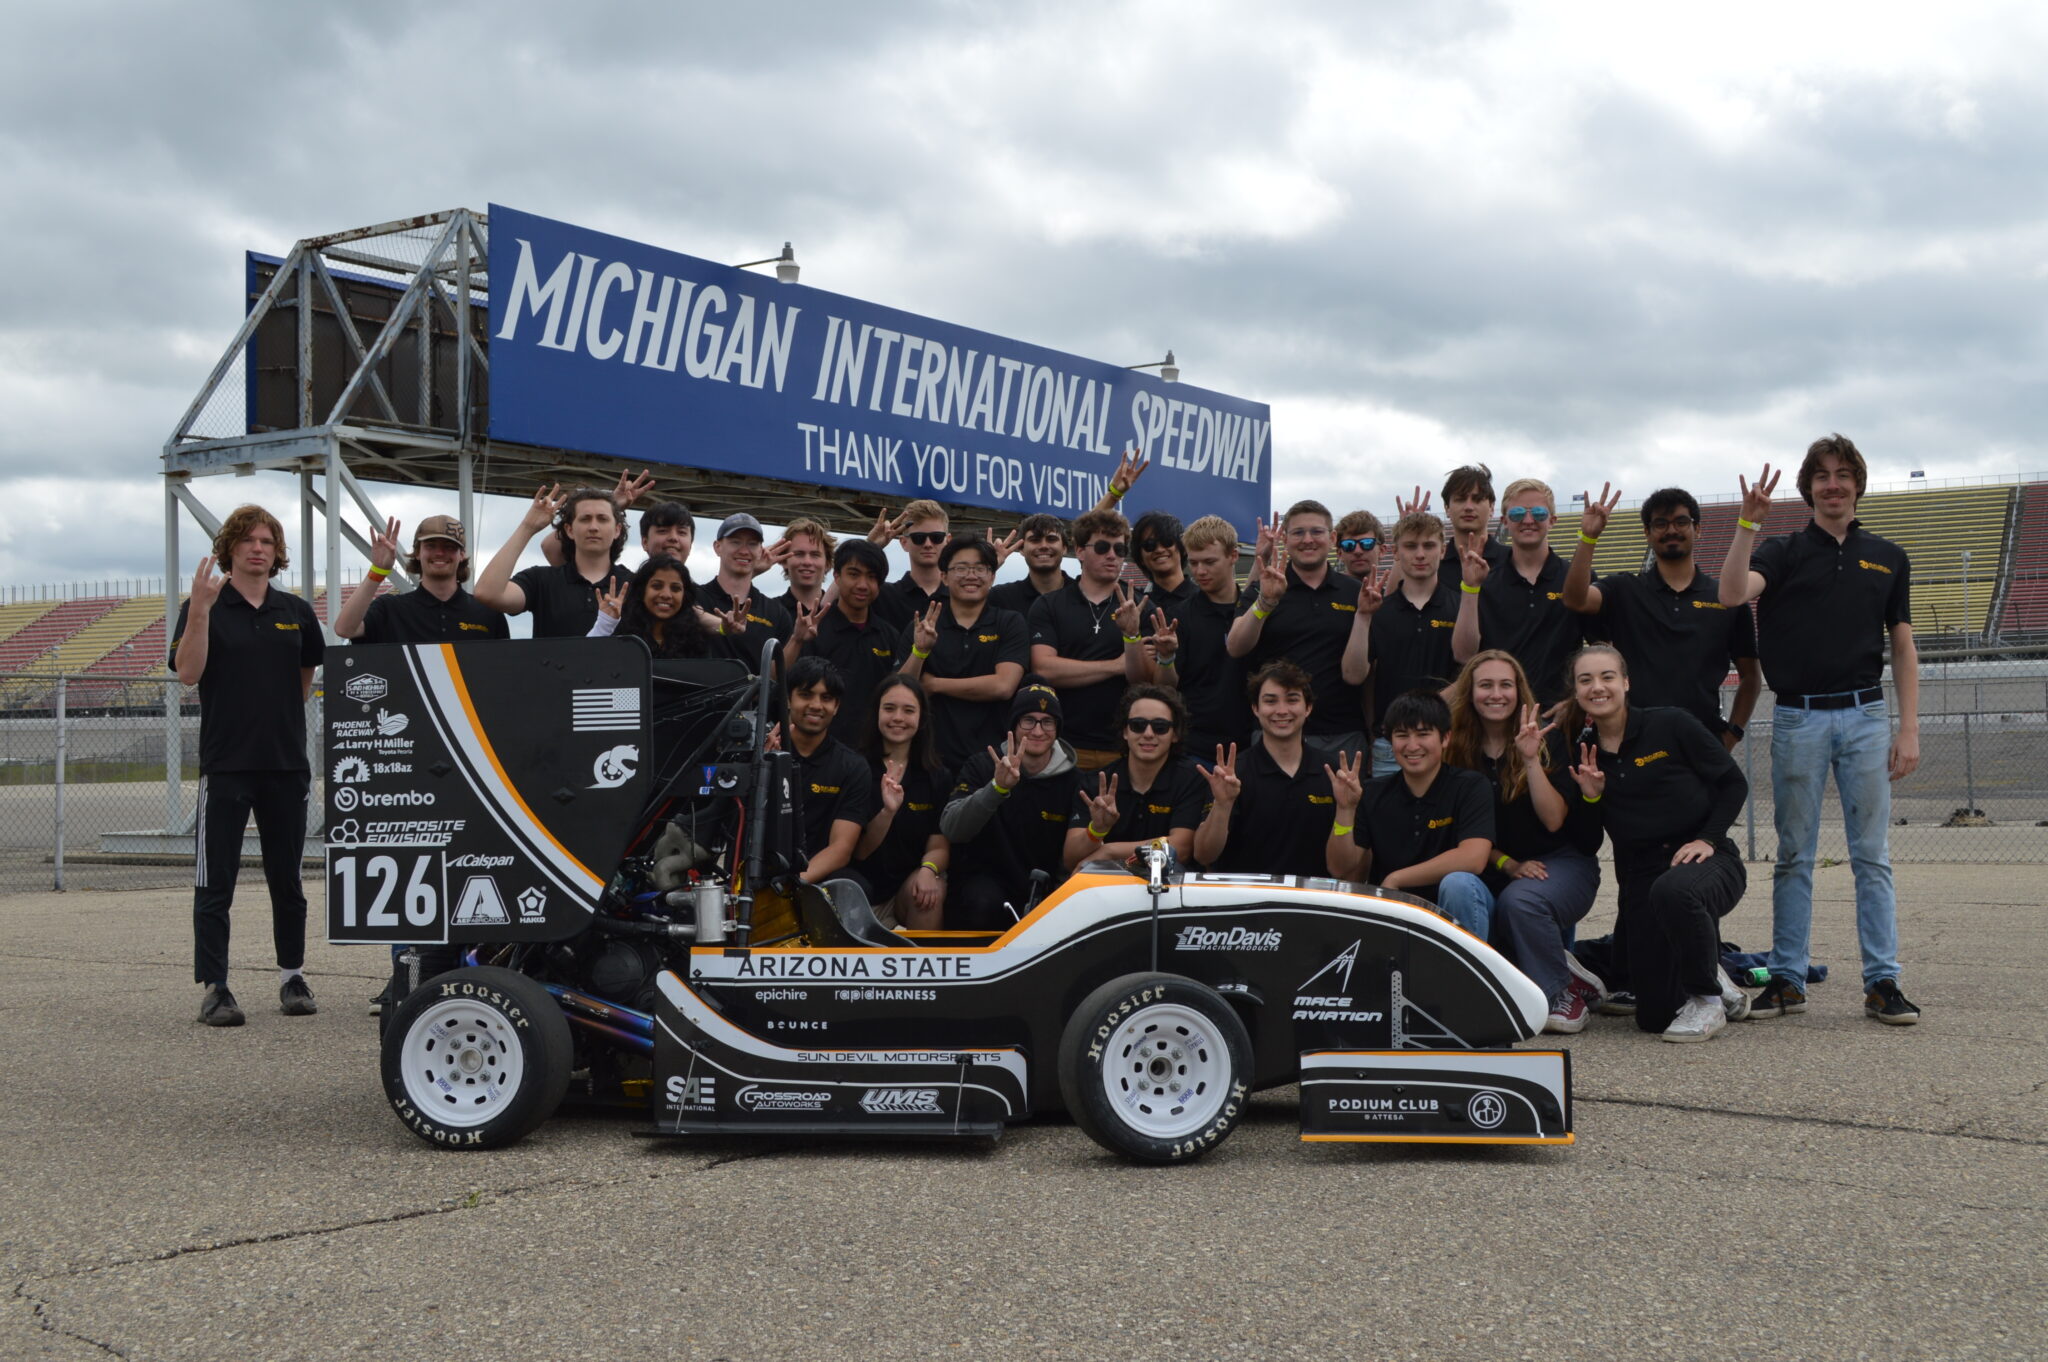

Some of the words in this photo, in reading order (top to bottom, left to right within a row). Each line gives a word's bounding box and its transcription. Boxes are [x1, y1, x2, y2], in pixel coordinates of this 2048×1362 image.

[495, 238, 802, 393] MICHIGAN
[812, 315, 1112, 455] INTERNATIONAL
[1126, 390, 1270, 483] SPEEDWAY
[797, 422, 903, 484] THANK
[911, 441, 968, 493] YOU
[976, 453, 1023, 501] FOR
[1030, 462, 1123, 516] VISITIN
[332, 720, 372, 730] PHOENIX
[336, 728, 376, 738] RACEWAY
[345, 739, 373, 751] Larry
[374, 739, 382, 748] H
[383, 737, 415, 749] Miller
[372, 762, 413, 774] 18x18az
[361, 789, 436, 807] brembo
[365, 820, 466, 833] COMPOSITE
[365, 832, 453, 844] ENVISIONS
[461, 853, 515, 870] Calspan
[334, 855, 437, 927] 126
[519, 916, 546, 924] HAKKO
[1187, 926, 1283, 945] RonDavis
[737, 956, 870, 977] ARIZONA
[881, 956, 972, 978] STATE
[755, 988, 808, 1003] epichire
[1293, 996, 1353, 1007] MACE
[439, 982, 529, 1029] Hoosier
[1292, 1010, 1383, 1022] AVIATION
[767, 1021, 828, 1030] BOUNCE
[1088, 984, 1166, 1063] Hoosier
[797, 1053, 830, 1062] SUN
[835, 1053, 880, 1062] DEVIL
[884, 1053, 1001, 1063] MOTORSPRTS
[665, 1075, 716, 1104] SAE
[744, 1092, 832, 1103] CROSSROAD
[865, 1089, 940, 1105] UMS
[755, 1101, 822, 1109] AUTOWORKS
[866, 1103, 939, 1112] TUNING
[1328, 1099, 1393, 1110] PODIUM
[1398, 1099, 1439, 1110] CLUB
